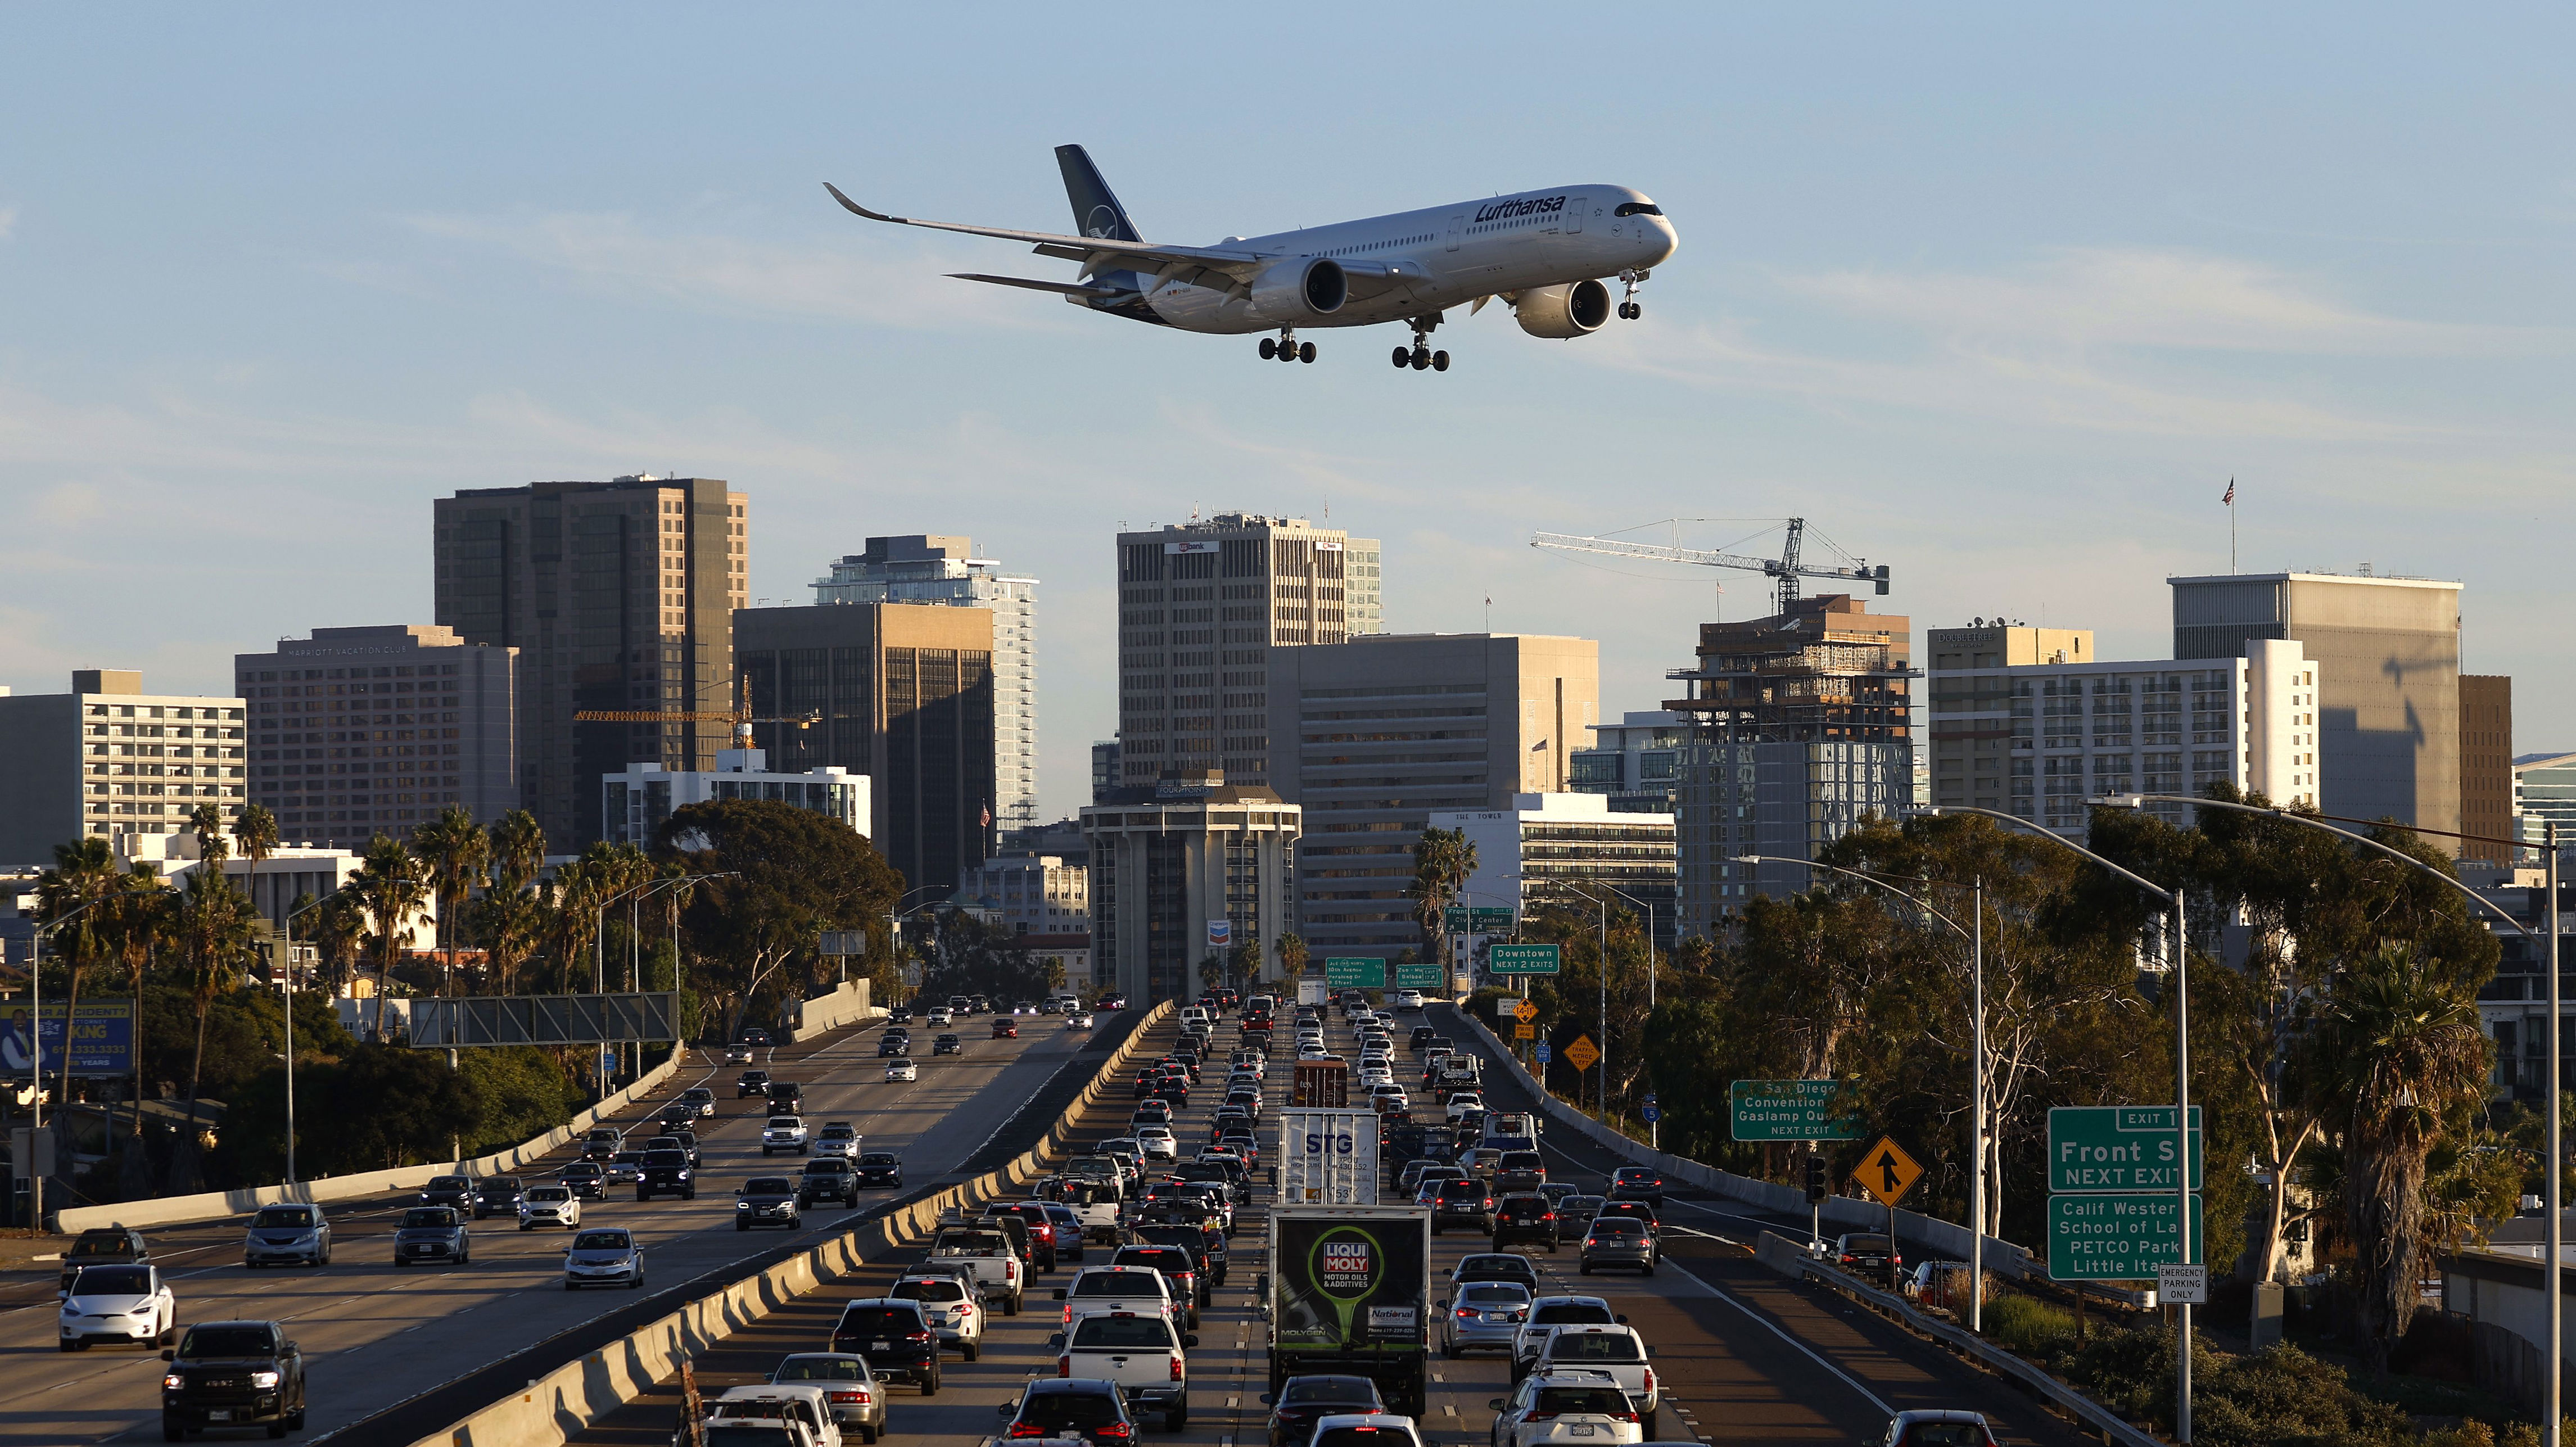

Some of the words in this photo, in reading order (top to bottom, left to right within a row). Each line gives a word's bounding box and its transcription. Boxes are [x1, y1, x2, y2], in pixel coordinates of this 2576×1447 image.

[1474, 196, 1567, 223] Lufthansa
[71, 1025, 107, 1038] KING
[52, 1045, 126, 1054] 61.333.3333
[1300, 1080, 1313, 1088] tex
[1797, 1083, 1836, 1096] Diego
[1745, 1097, 1825, 1108] Convention
[1649, 1110, 1656, 1119] 5
[1739, 1111, 1800, 1123] Gaslamp
[2128, 1114, 2160, 1123] EXIT
[1805, 1126, 1829, 1134] EXIT
[1307, 1134, 1353, 1154] STG
[2061, 1141, 2141, 1162] Front
[2158, 1140, 2175, 1161] S
[2066, 1169, 2125, 1184] NEXT
[2063, 1202, 2105, 1215] Calif
[2114, 1202, 2176, 1215] Wester
[2059, 1221, 2119, 1235] School
[2129, 1221, 2146, 1234] of
[2157, 1220, 2177, 1233] La
[1326, 1245, 1367, 1258] LIQUI
[2071, 1240, 2130, 1254] PETCO
[2139, 1240, 2179, 1254] Park
[1326, 1258, 1367, 1270] MOLY
[2073, 1259, 2125, 1272] Little
[2161, 1268, 2204, 1277] EMERGENCY
[2164, 1279, 2201, 1288] PARKING
